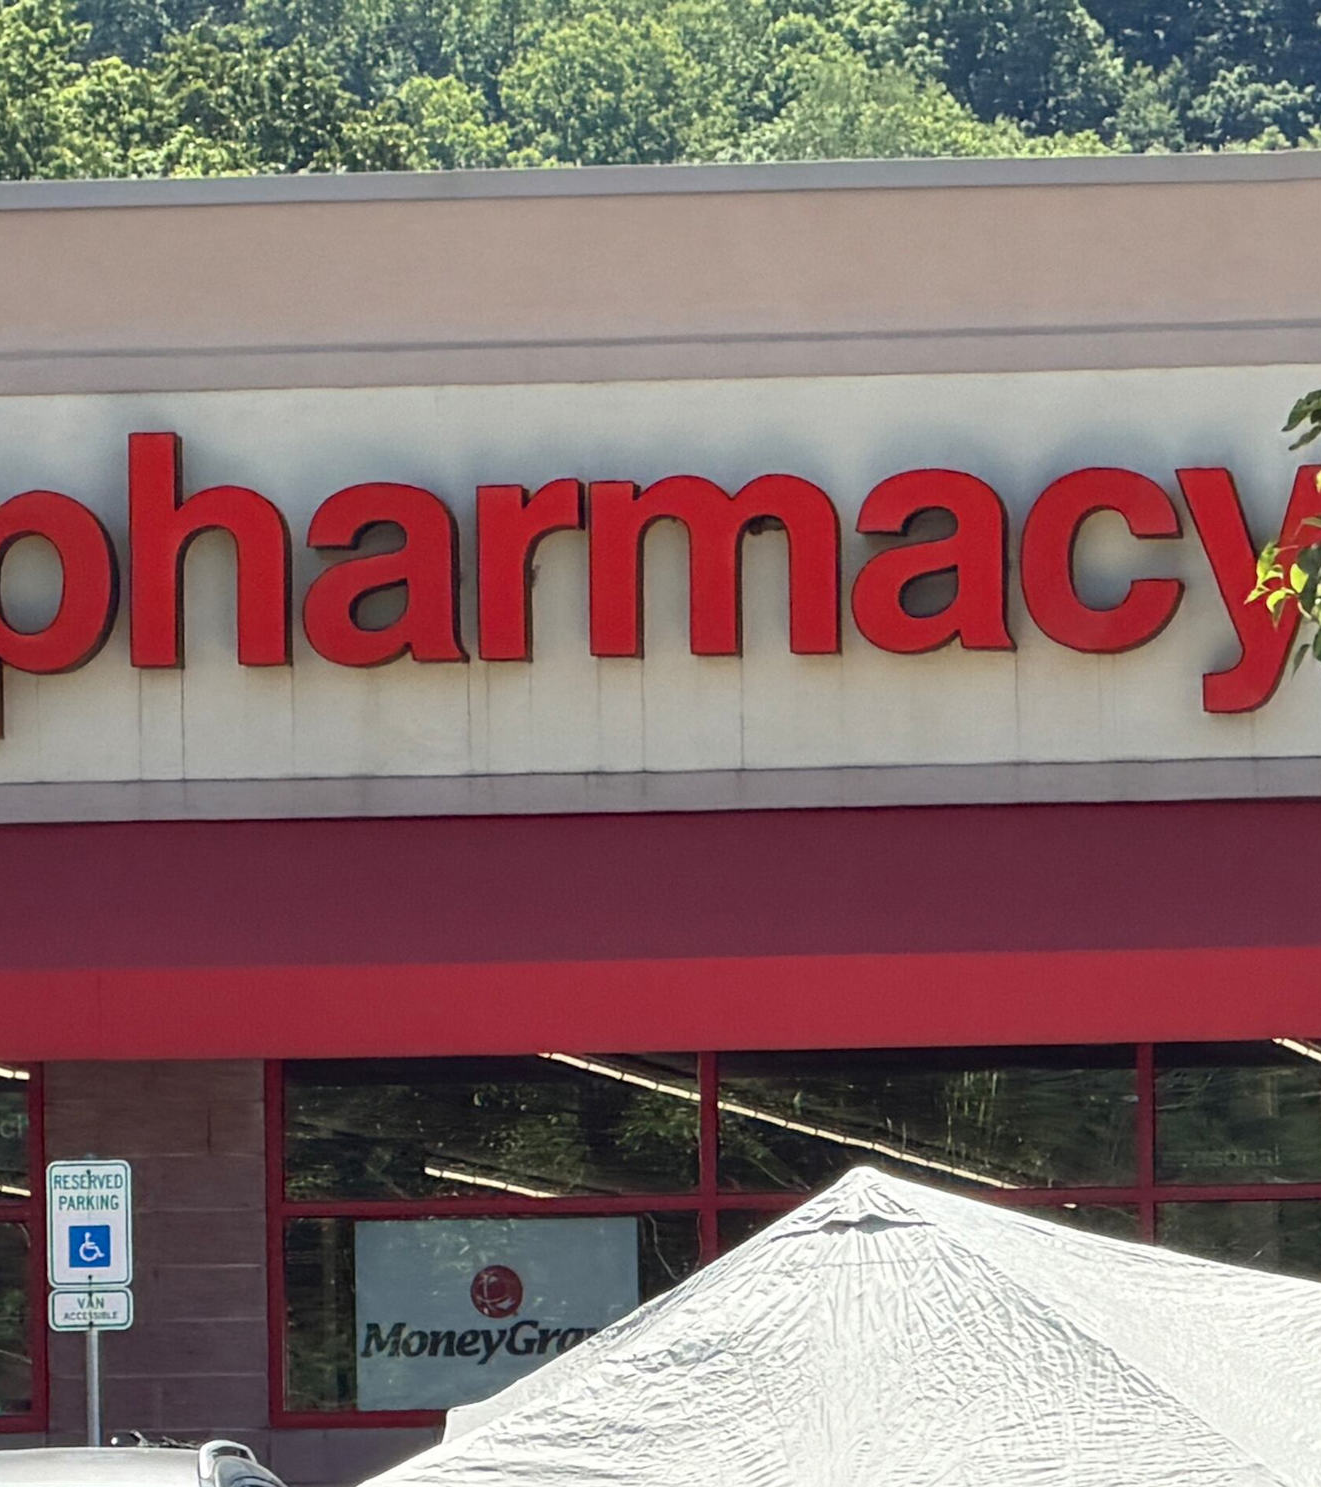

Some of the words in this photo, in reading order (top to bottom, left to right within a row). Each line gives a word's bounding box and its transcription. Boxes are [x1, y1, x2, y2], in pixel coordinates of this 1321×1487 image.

[54, 1174, 123, 1190] RESERVED
[59, 1195, 119, 1211] PARKING
[77, 1296, 105, 1309] VAN
[360, 1320, 600, 1364] MoneyGra
